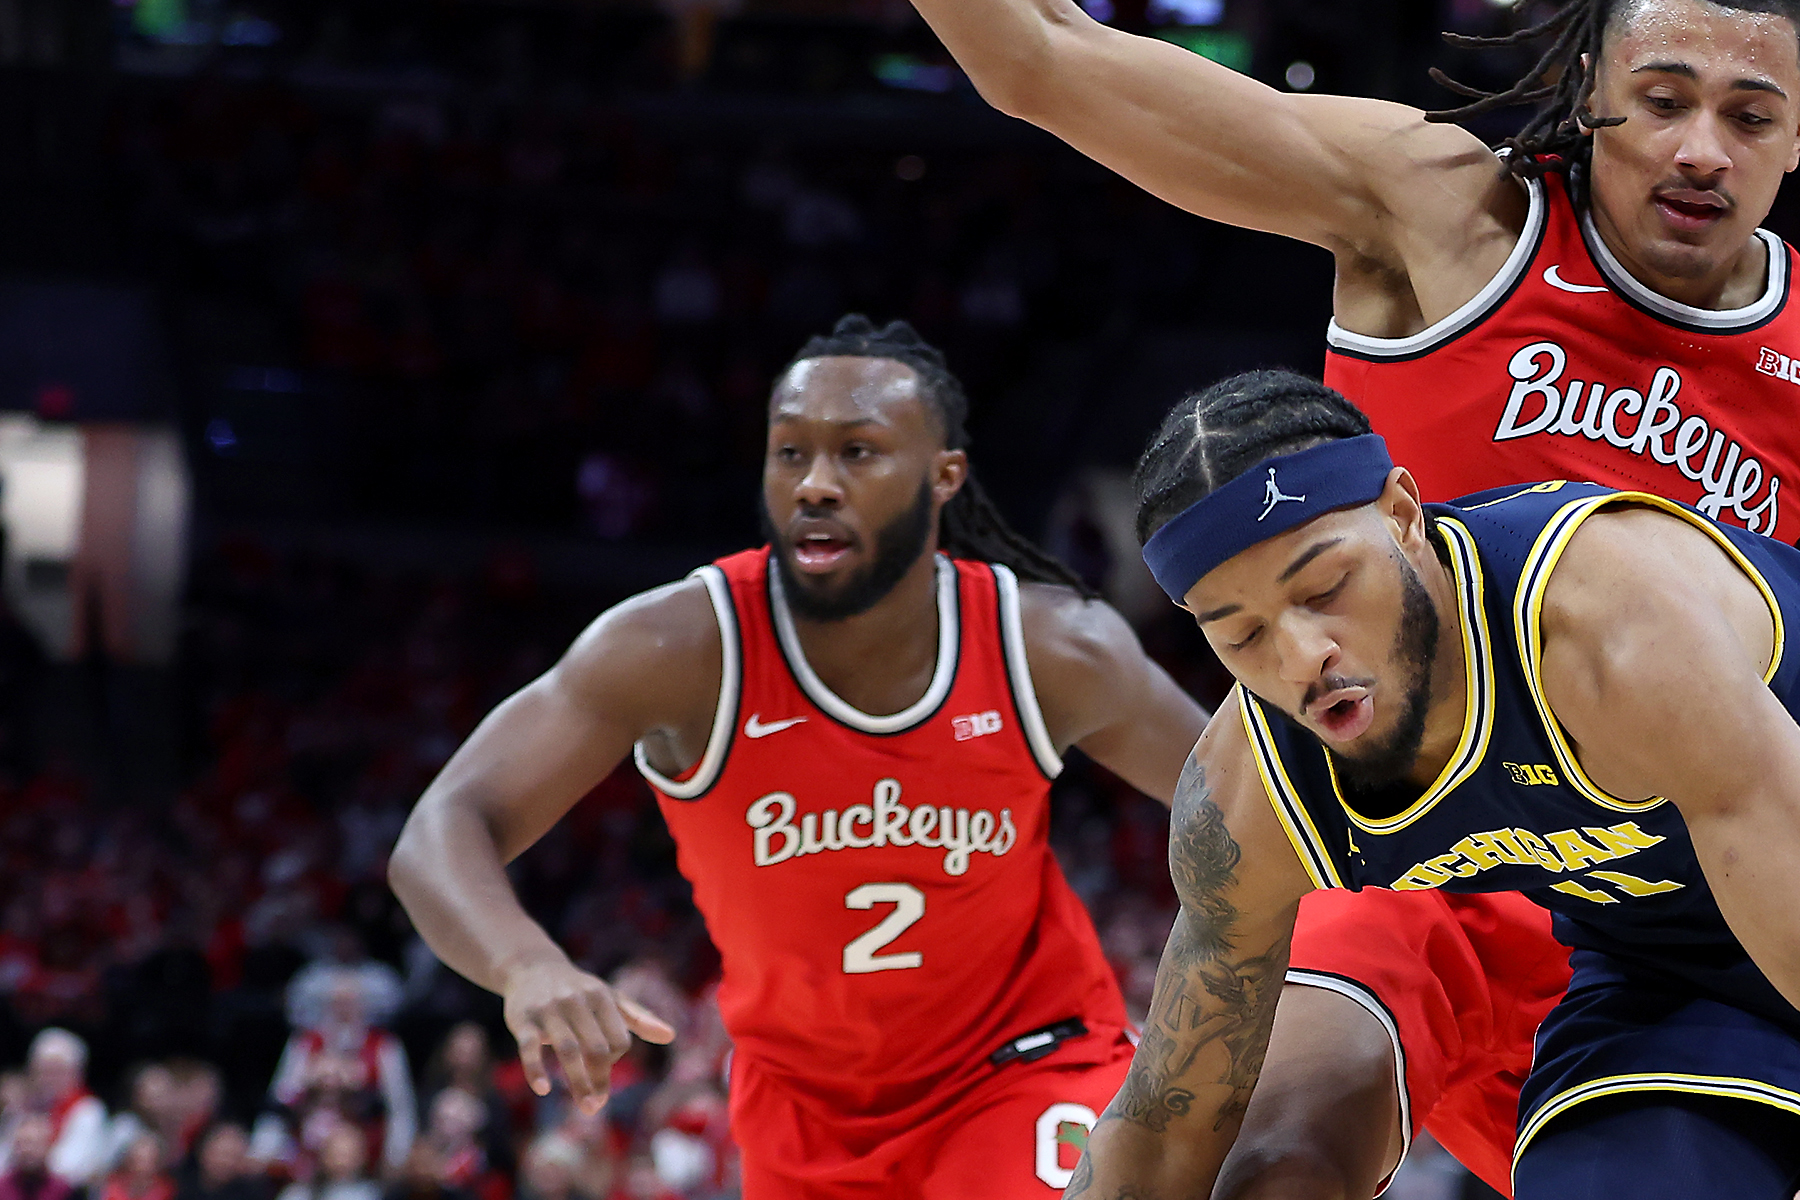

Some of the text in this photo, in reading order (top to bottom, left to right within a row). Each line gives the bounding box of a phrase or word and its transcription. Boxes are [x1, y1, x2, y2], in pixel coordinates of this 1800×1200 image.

[1492, 340, 1779, 538] Buckeyes
[1502, 761, 1559, 786] BIG
[745, 777, 1017, 876] Buckeyes
[842, 882, 926, 974] 2
